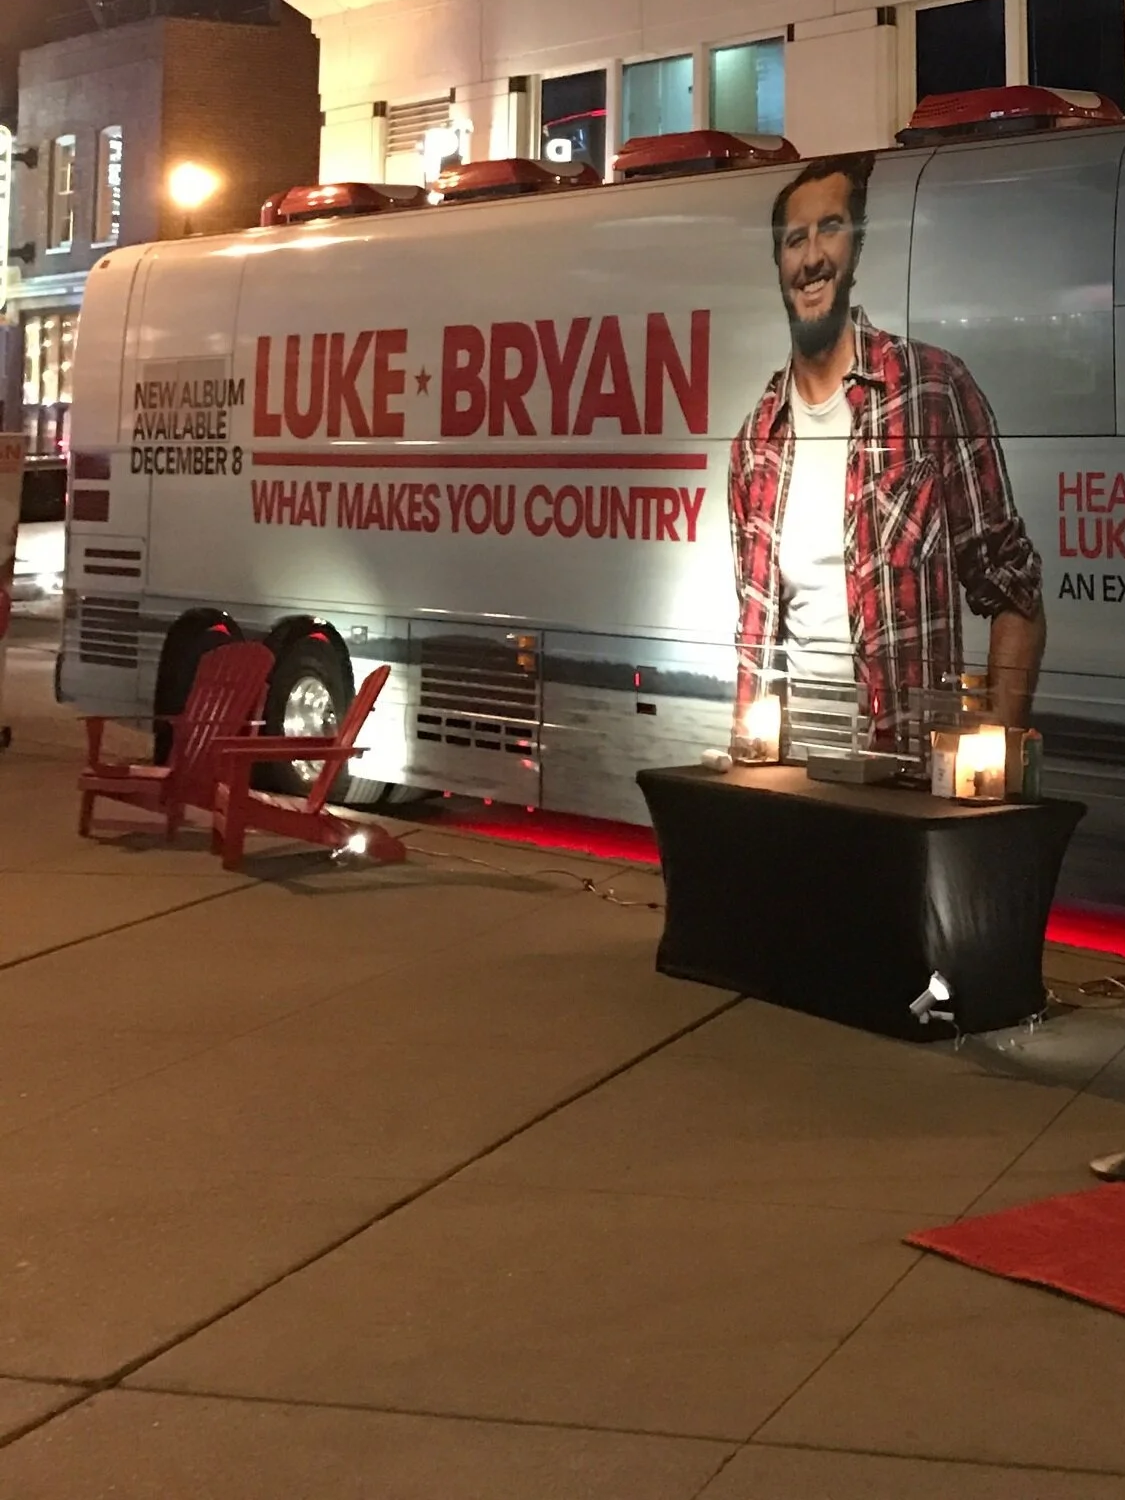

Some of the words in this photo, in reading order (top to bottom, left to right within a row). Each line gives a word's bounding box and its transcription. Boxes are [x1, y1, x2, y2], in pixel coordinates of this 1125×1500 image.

[253, 328, 408, 439] LUKE
[440, 309, 711, 437] BRYAN
[134, 381, 177, 410] NEW
[181, 378, 245, 408] ALBUM
[133, 410, 227, 440] AVAILABLE
[131, 446, 227, 475] DECEMBER
[231, 446, 243, 475] 8
[251, 480, 332, 526] WHAT
[337, 482, 441, 533] MAKES
[447, 483, 517, 536] YOU
[524, 484, 707, 542] COUNTRY
[1058, 572, 1095, 601] AN
